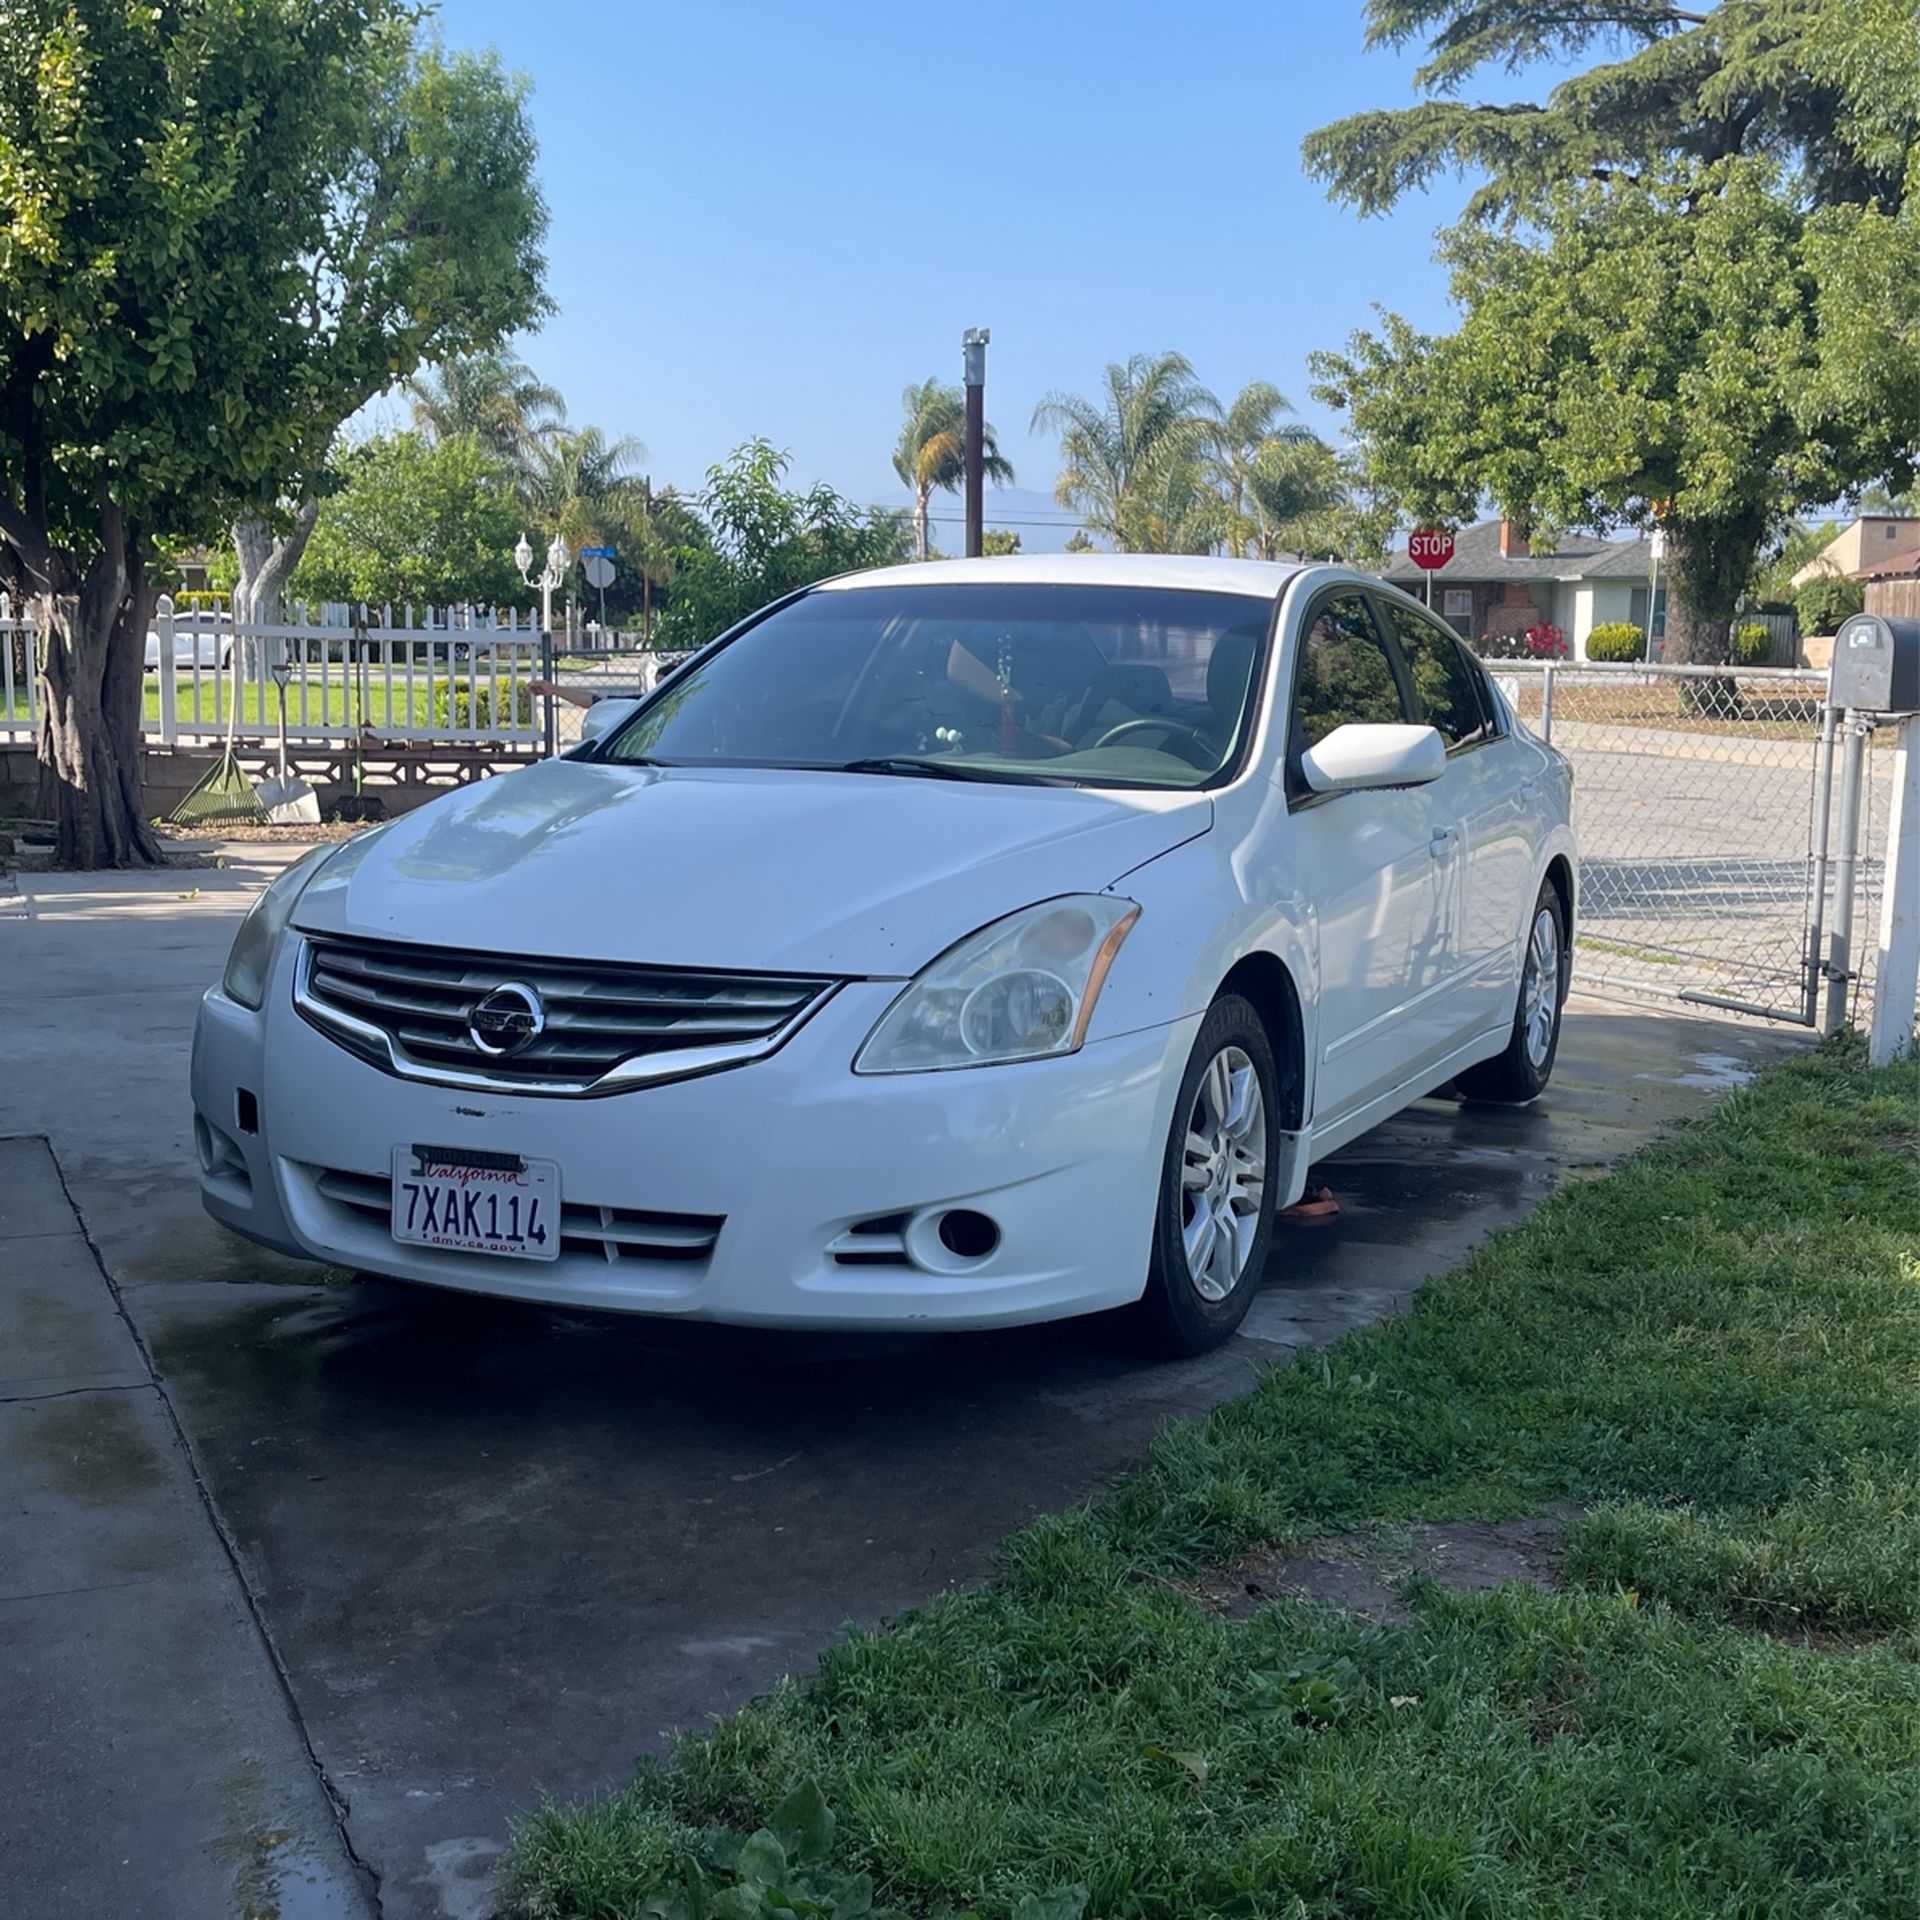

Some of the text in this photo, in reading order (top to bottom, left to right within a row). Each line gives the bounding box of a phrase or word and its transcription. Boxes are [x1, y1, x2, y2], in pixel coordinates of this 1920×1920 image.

[1411, 537, 1452, 555] STOP
[427, 1163, 529, 1187] California
[402, 1183, 547, 1245] 7XAK114
[432, 1236, 517, 1252] dmv.ca.gov
